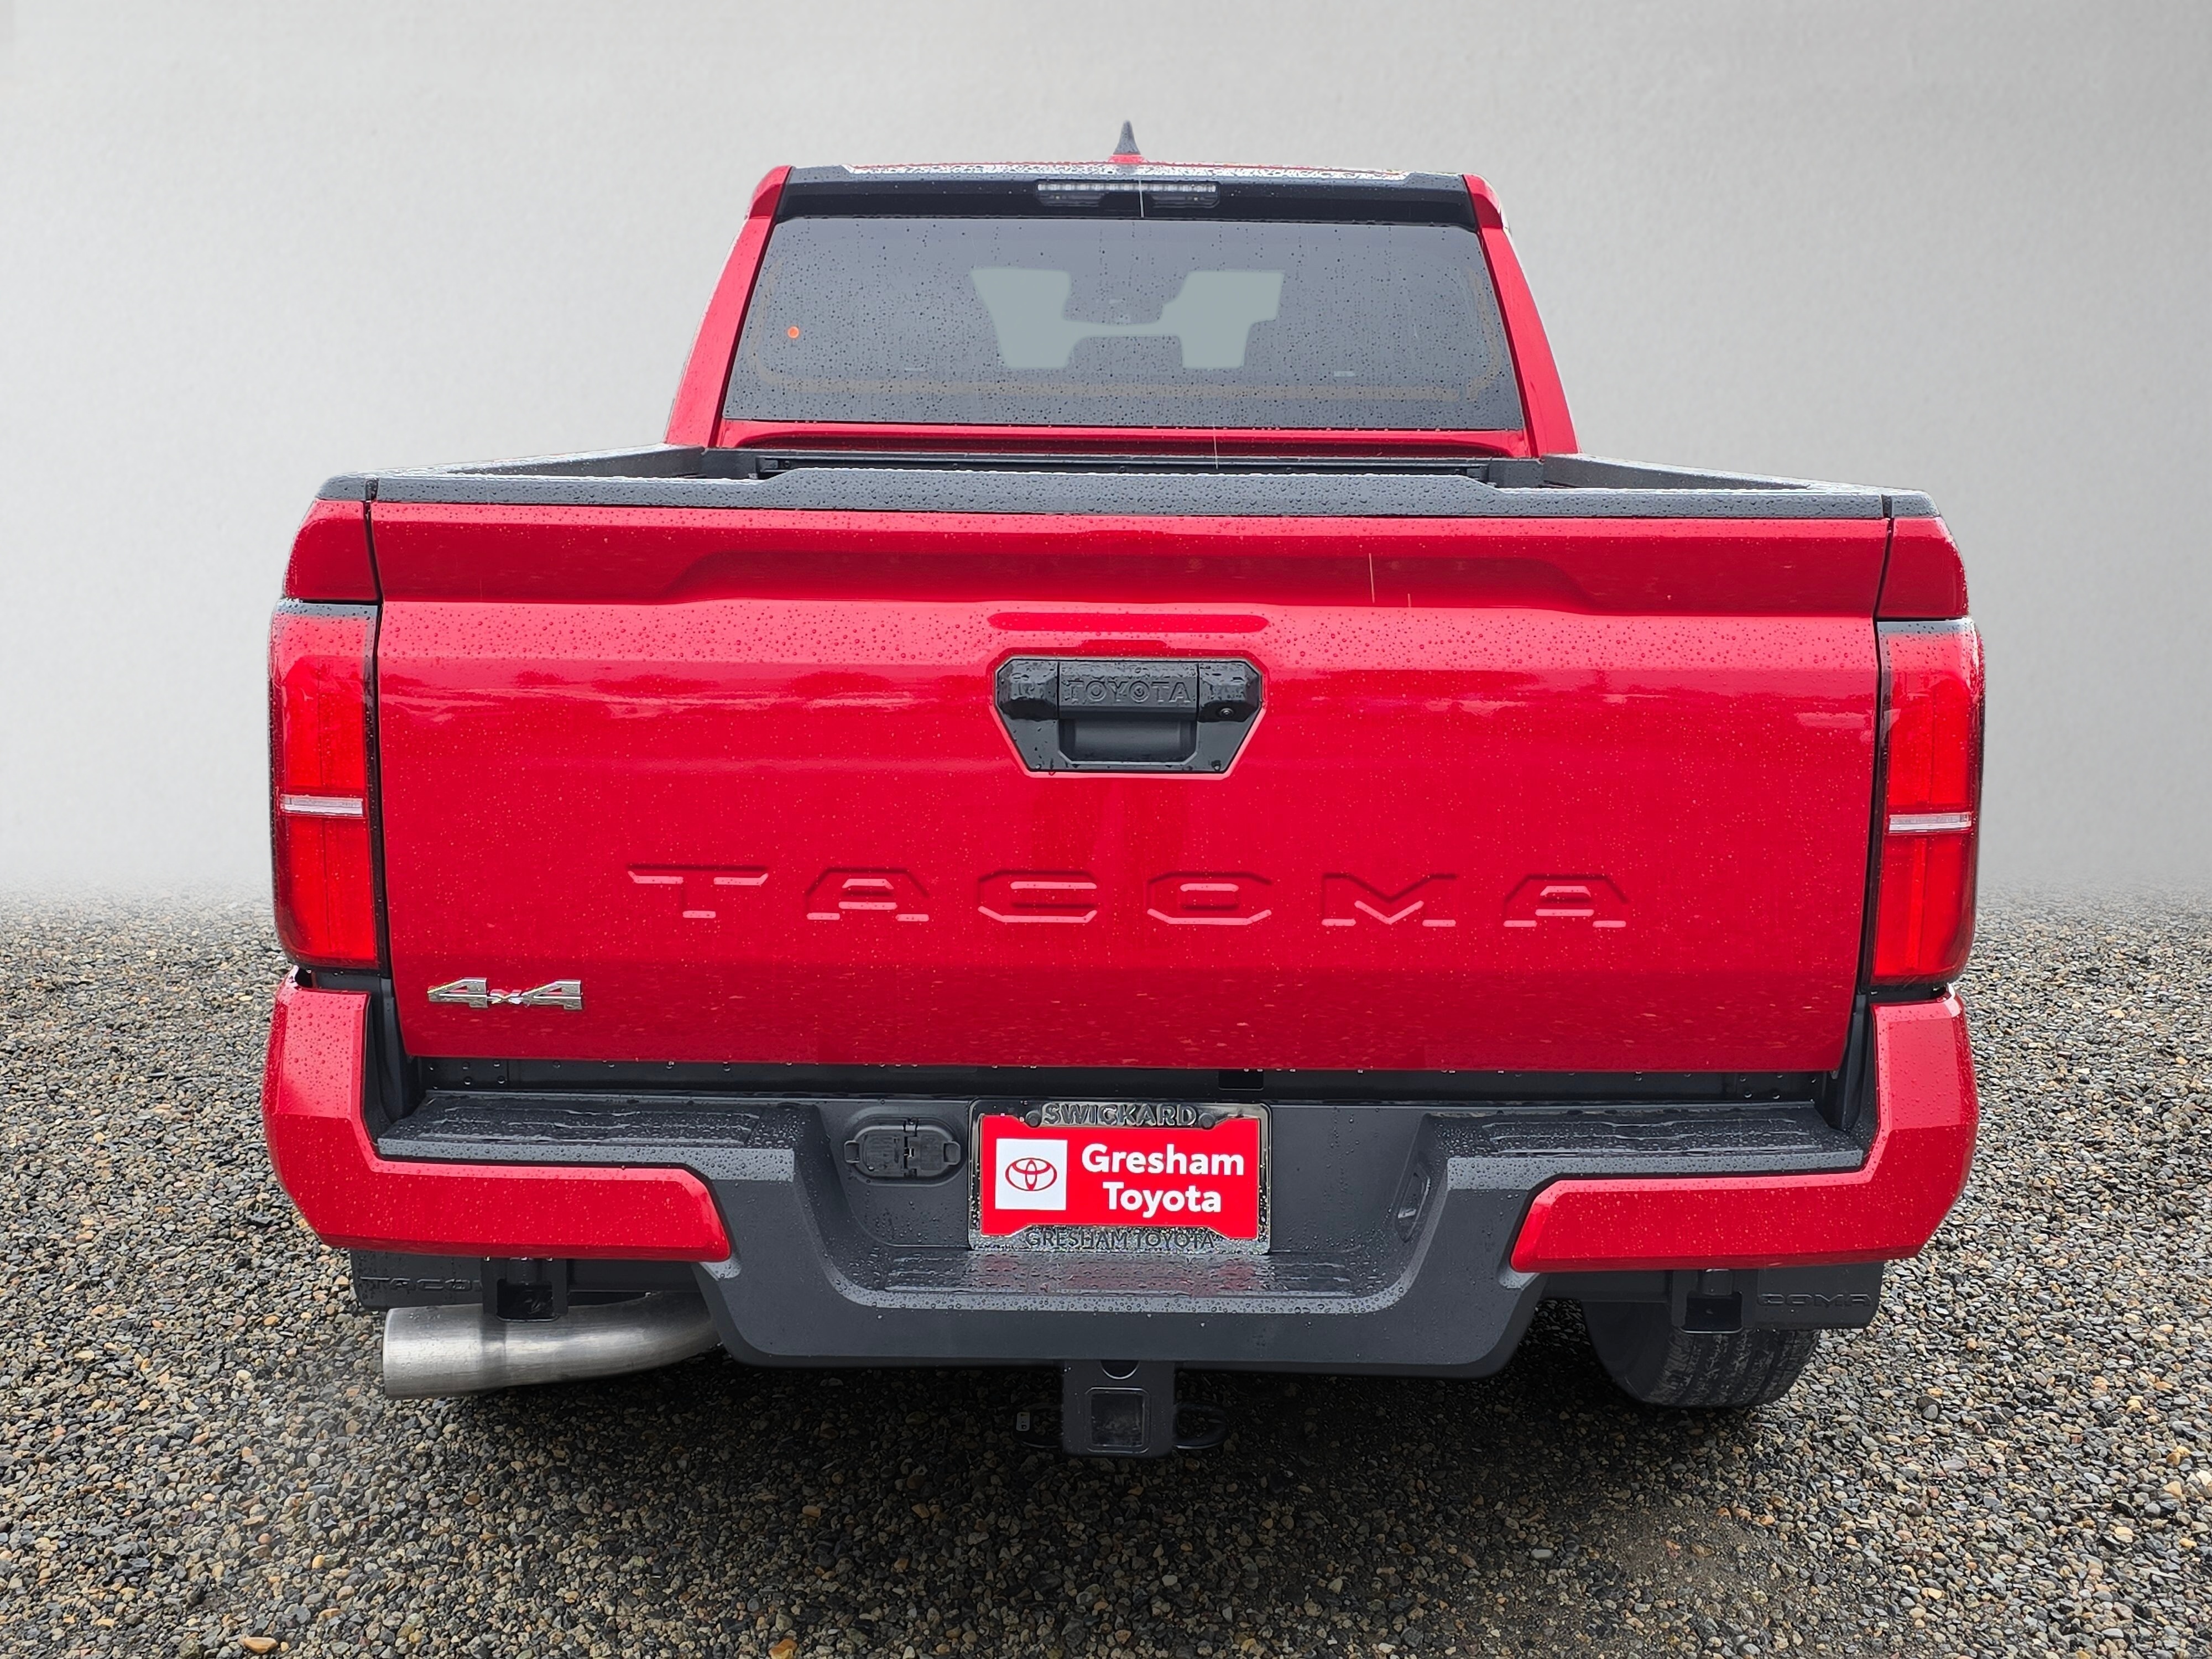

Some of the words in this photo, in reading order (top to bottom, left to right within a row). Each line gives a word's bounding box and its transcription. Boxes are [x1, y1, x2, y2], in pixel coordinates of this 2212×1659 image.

[1066, 680, 1191, 703] TOYOTA
[627, 864, 1629, 929] TACOMA
[1042, 1103, 1197, 1126] SWICKARD
[1081, 1143, 1245, 1176] Gresham
[1102, 1181, 1222, 1218] Toyota
[1025, 1229, 1127, 1248] GRESHAM
[1131, 1230, 1215, 1250] TOYOTA
[360, 1276, 482, 1292] TACO
